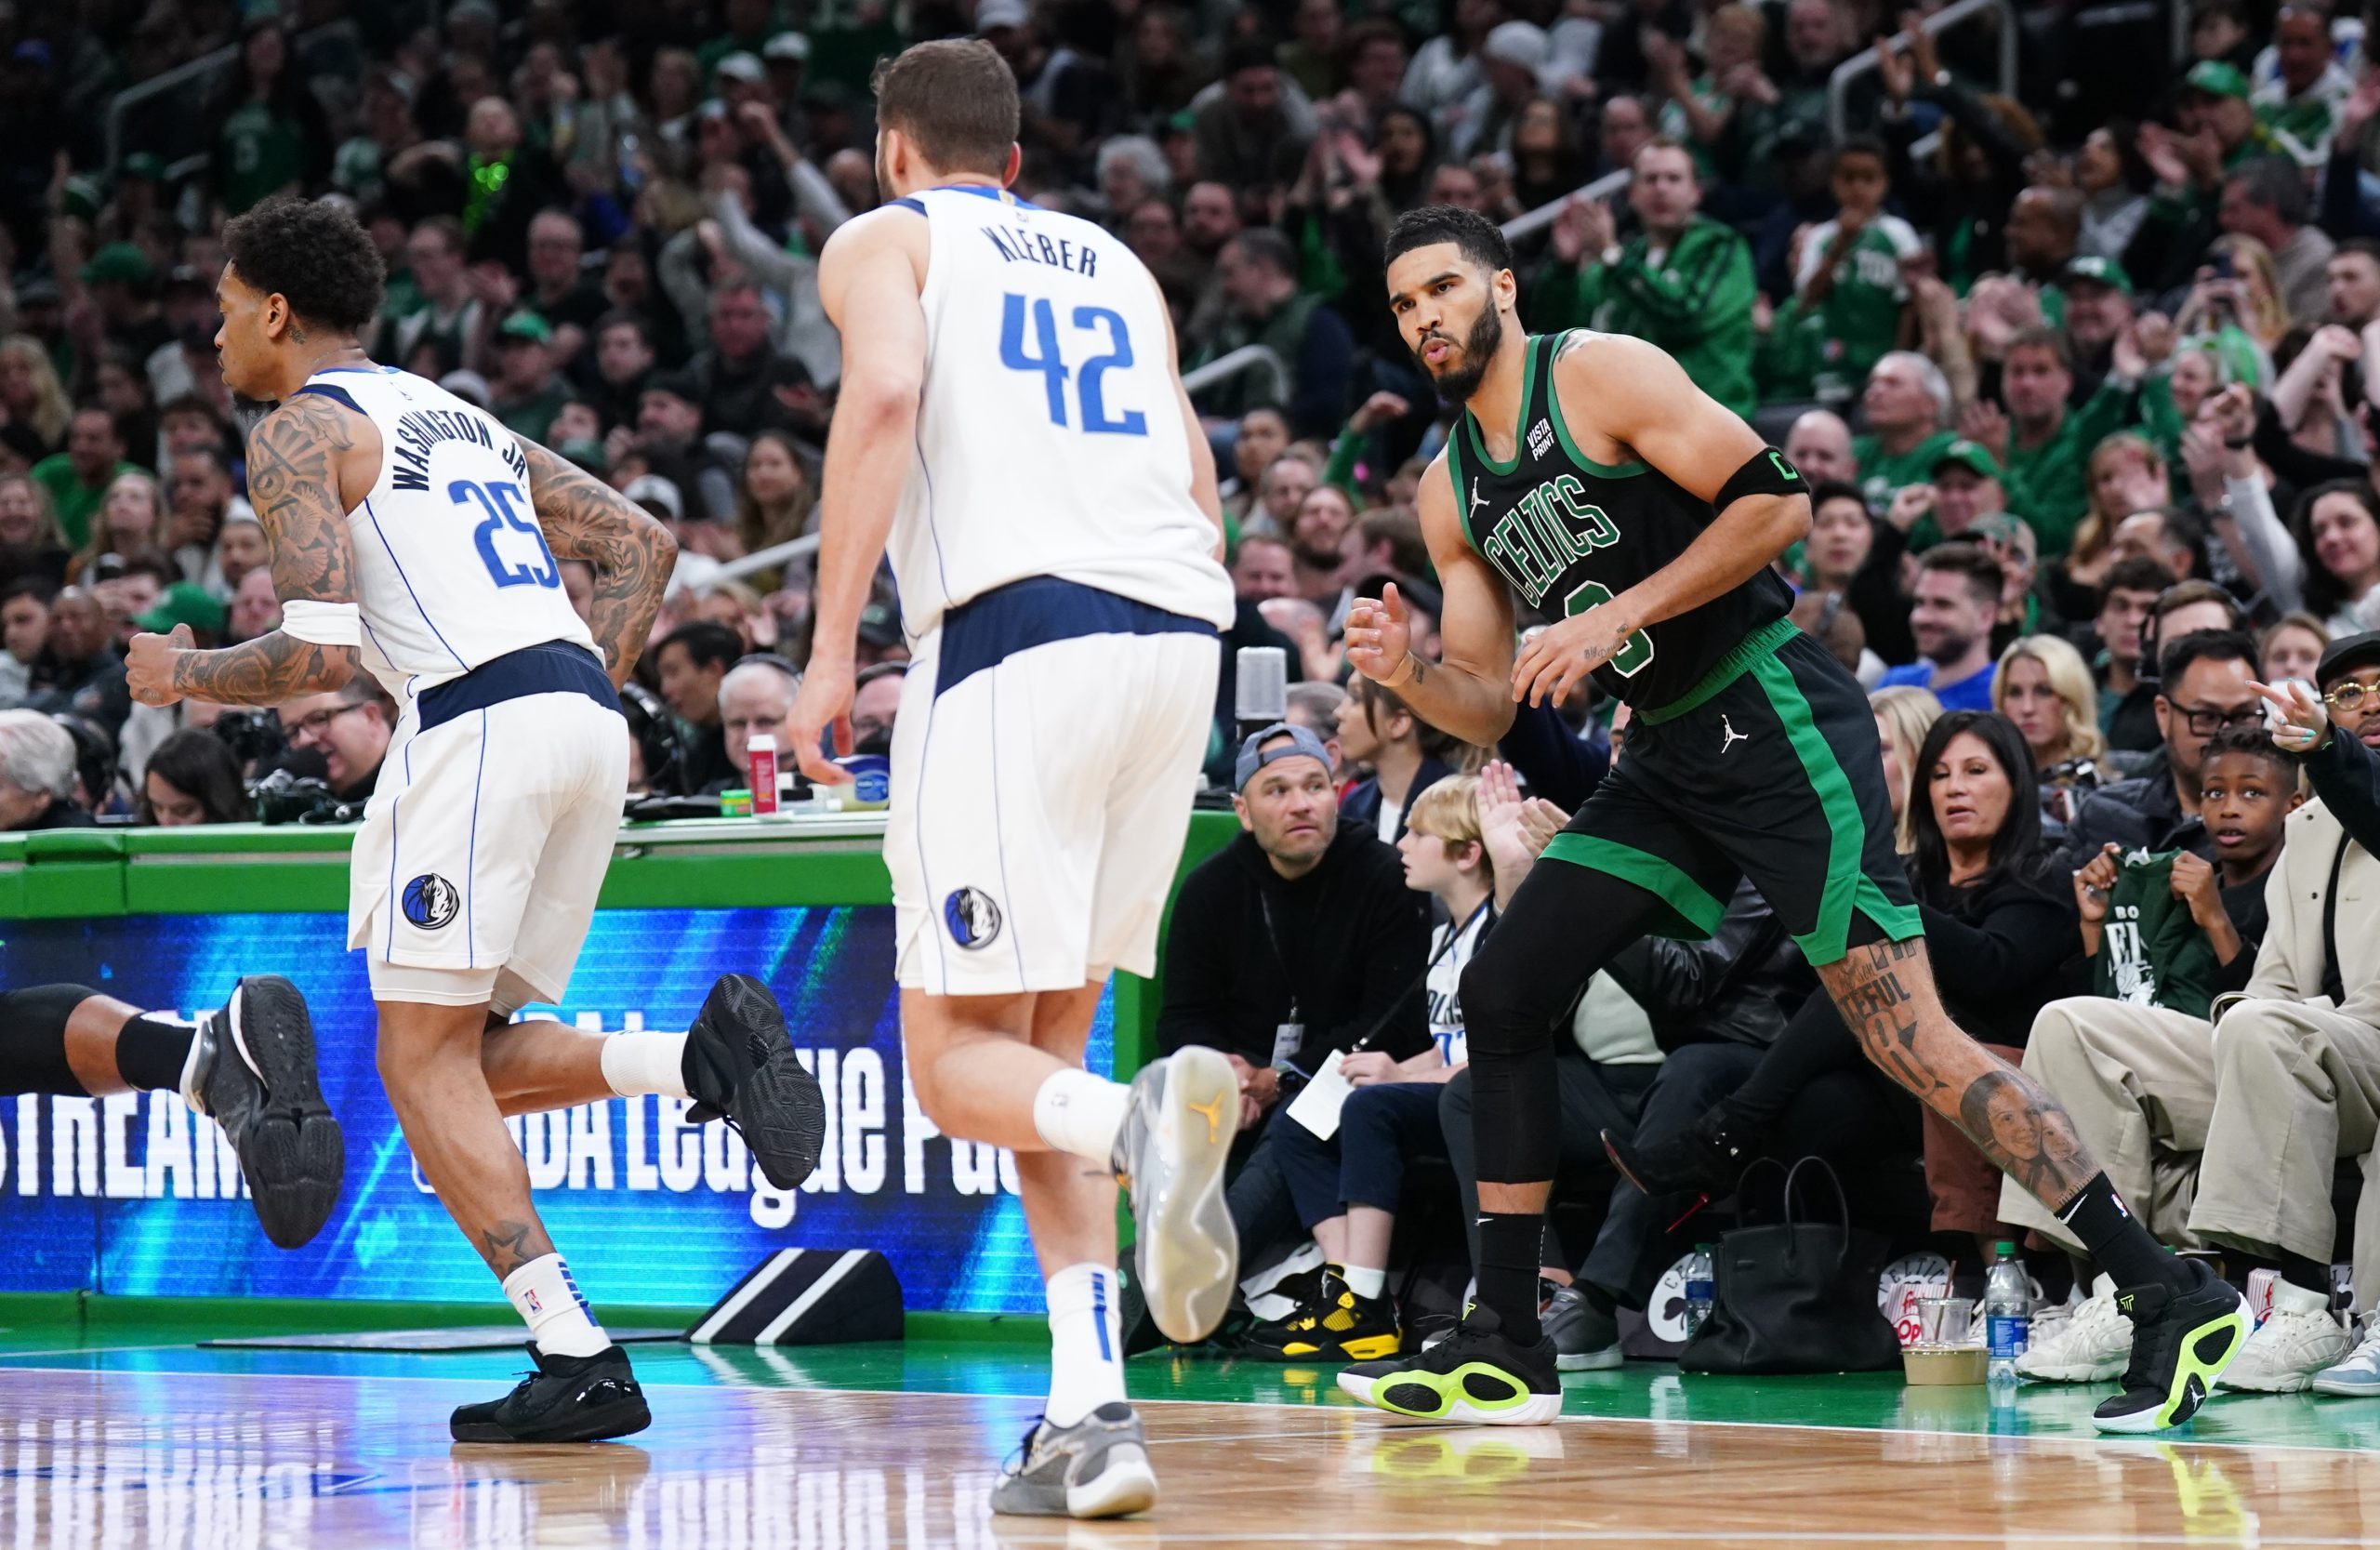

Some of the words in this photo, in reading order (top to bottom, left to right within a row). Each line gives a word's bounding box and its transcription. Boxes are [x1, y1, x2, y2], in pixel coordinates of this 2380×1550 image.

[980, 224, 1097, 278] KLEBER
[999, 292, 1149, 435] 42
[392, 409, 494, 492] WASHINGTON
[502, 442, 527, 489] JR.
[1527, 417, 1552, 449] VISTA
[1531, 431, 1555, 461] PRINT
[447, 480, 561, 590] 25
[1484, 473, 1621, 609] CELTICS
